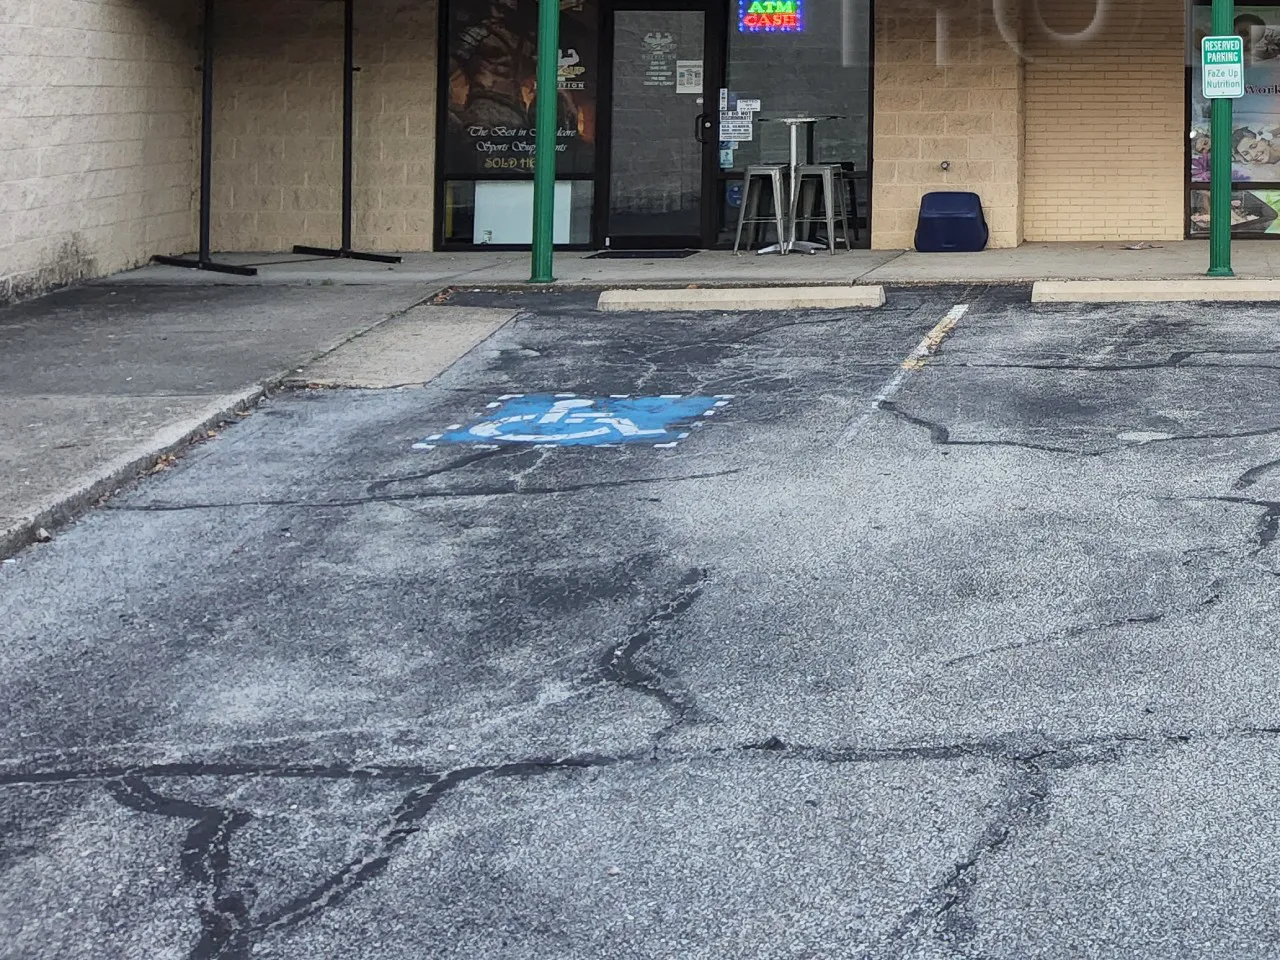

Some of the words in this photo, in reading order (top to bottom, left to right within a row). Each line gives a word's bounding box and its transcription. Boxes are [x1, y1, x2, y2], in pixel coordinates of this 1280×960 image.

[748, 0, 793, 13] ATM
[743, 13, 796, 26] CASH
[1205, 40, 1240, 51] RESERVED
[1207, 52, 1238, 62] PARKING
[1208, 69, 1225, 78] FaZe
[1228, 69, 1238, 78] Up
[1207, 80, 1240, 88] Nutrition
[468, 126, 489, 136] The
[491, 126, 515, 136] Best
[518, 127, 527, 136] in
[476, 141, 509, 154] Sports
[484, 158, 518, 168] SOLD
